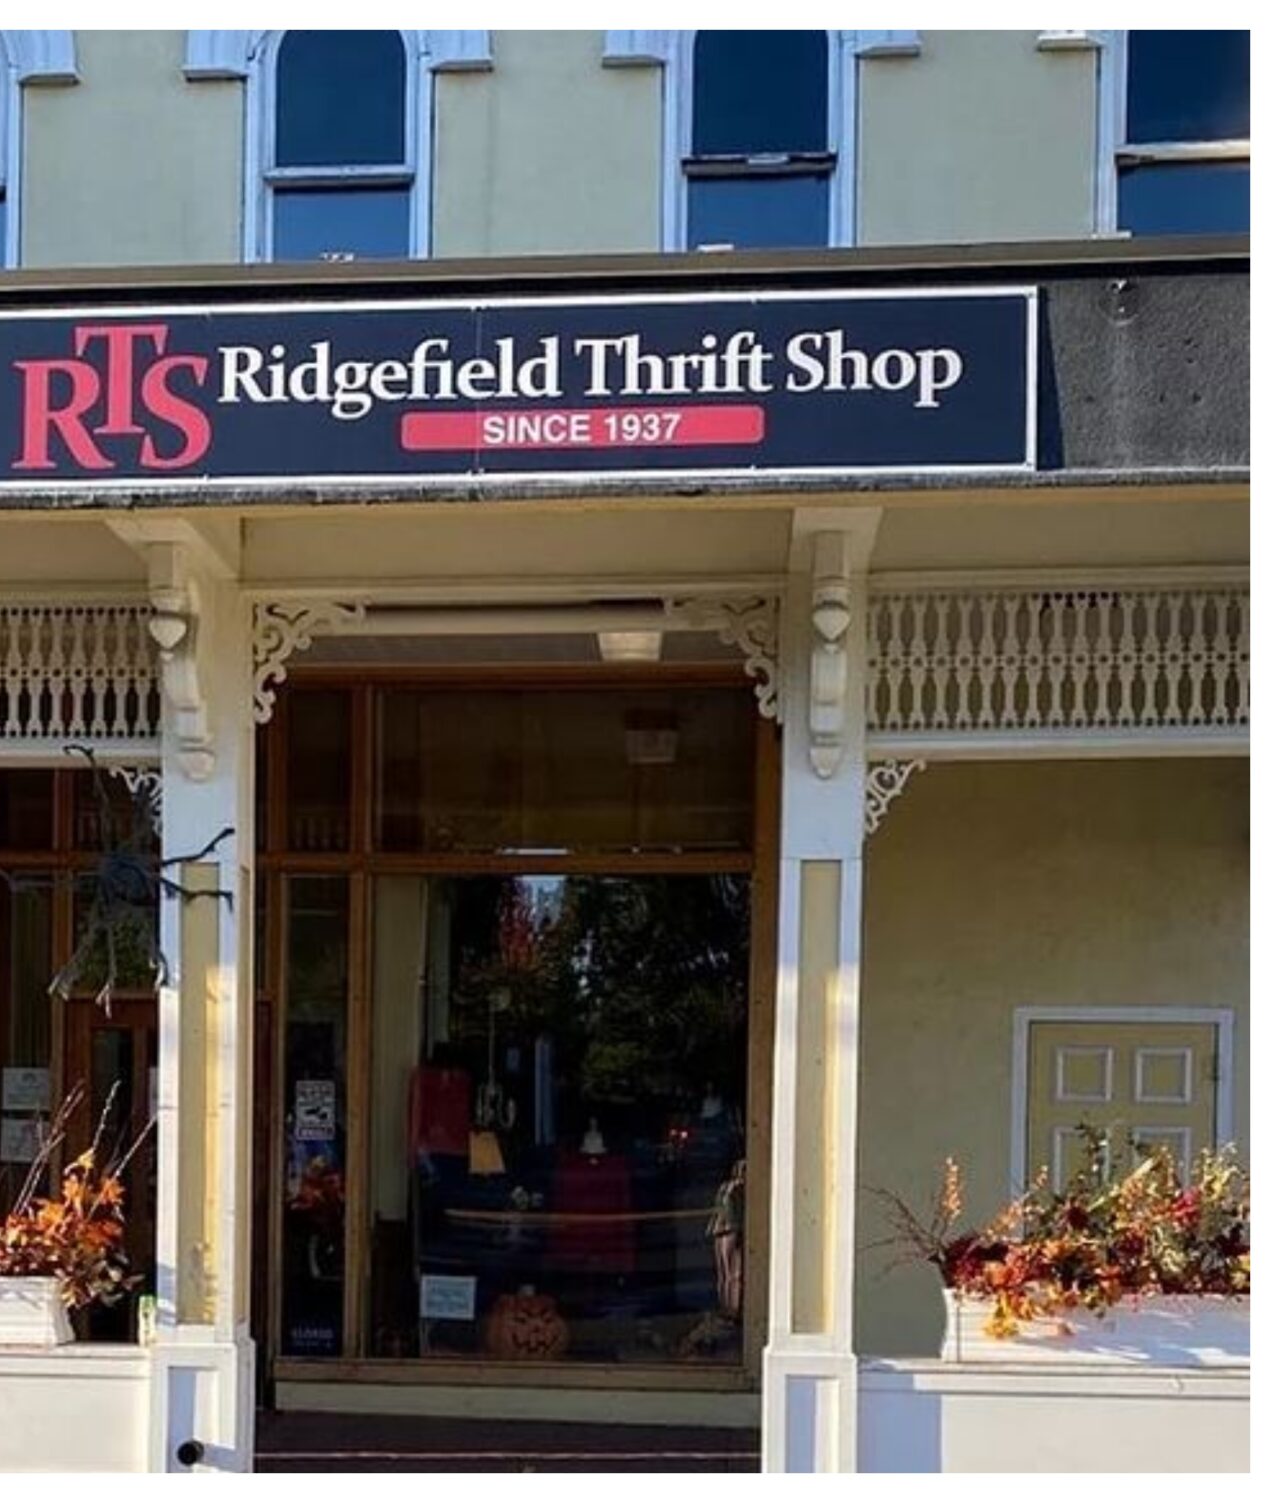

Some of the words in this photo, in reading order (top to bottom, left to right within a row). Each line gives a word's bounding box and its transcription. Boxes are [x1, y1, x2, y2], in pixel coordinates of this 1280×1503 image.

[11, 324, 213, 469] RTS
[218, 336, 562, 419] Ridgefield
[574, 331, 773, 396] Thrift
[786, 329, 963, 408] Shop
[483, 414, 591, 444] SINCE
[604, 413, 682, 442] 1937
